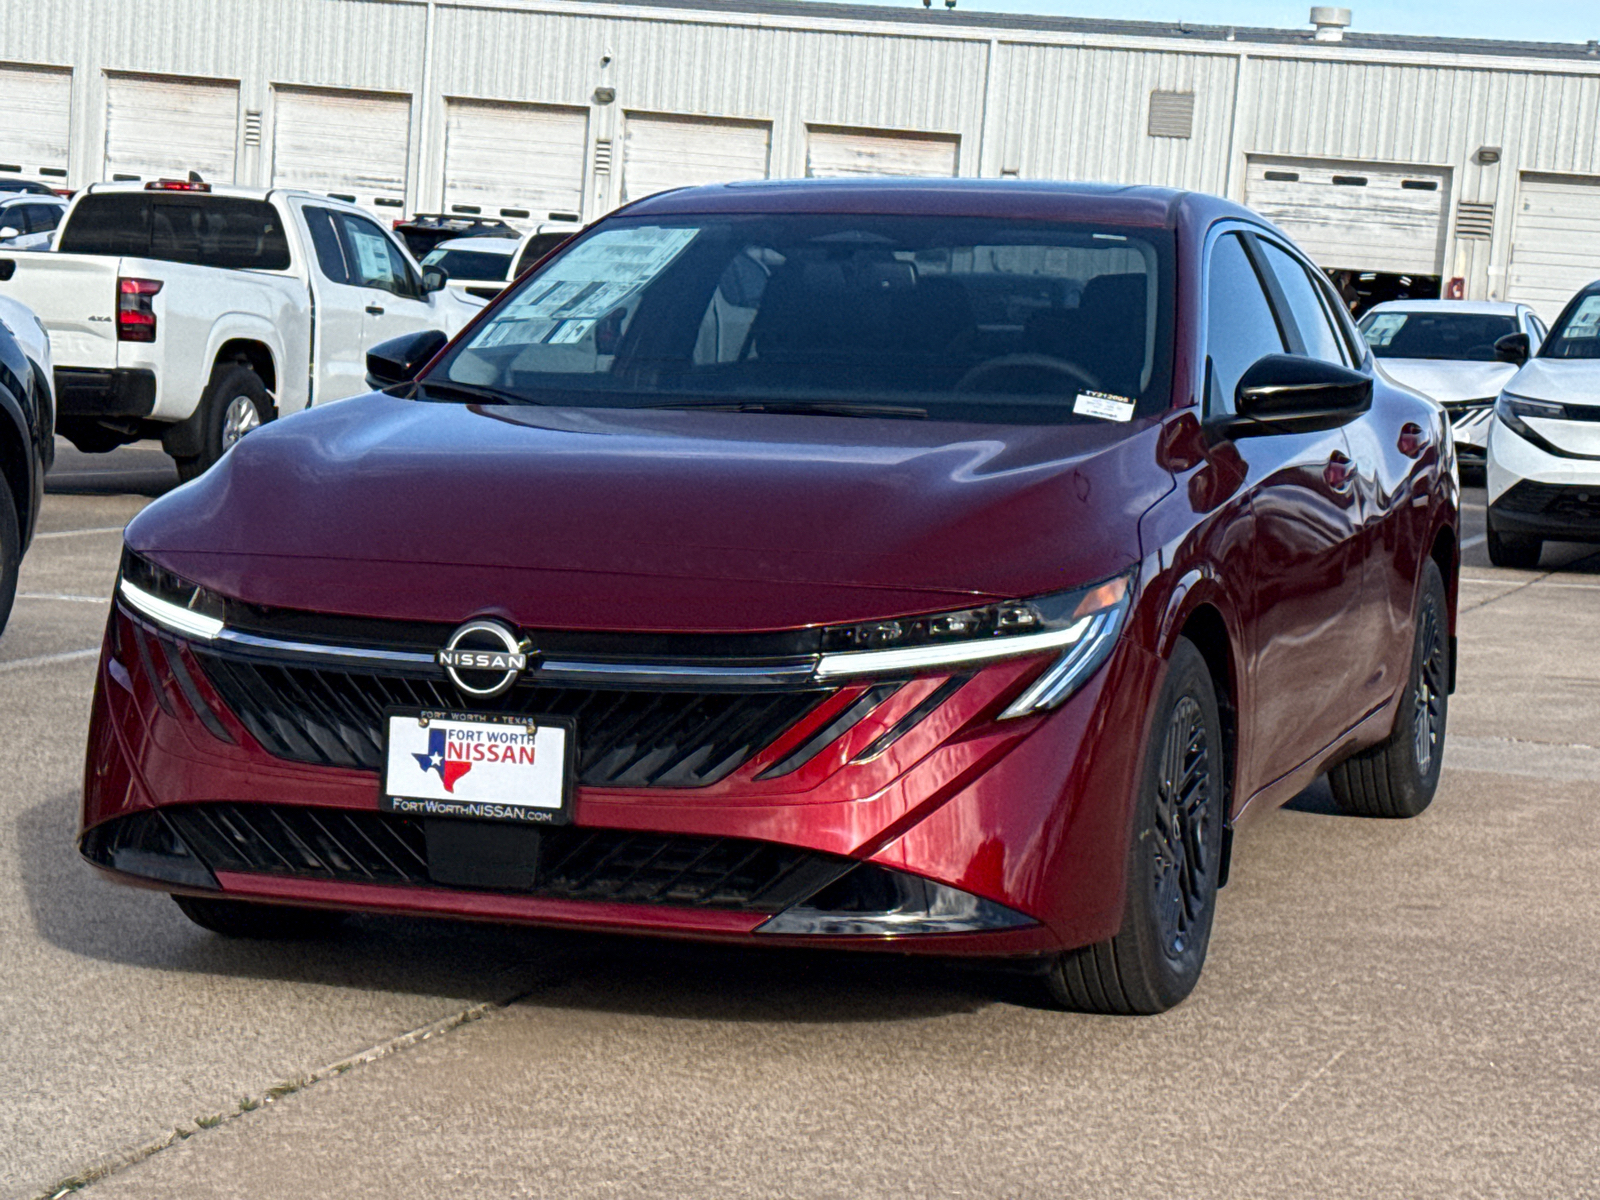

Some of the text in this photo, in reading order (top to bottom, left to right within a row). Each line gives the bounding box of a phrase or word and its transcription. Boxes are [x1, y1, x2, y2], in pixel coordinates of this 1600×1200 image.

[439, 651, 525, 669] NISSAN
[421, 710, 534, 725] FORT WORTH TEXAS
[448, 729, 535, 745] FORT WORTH
[447, 741, 535, 765] NISSAN
